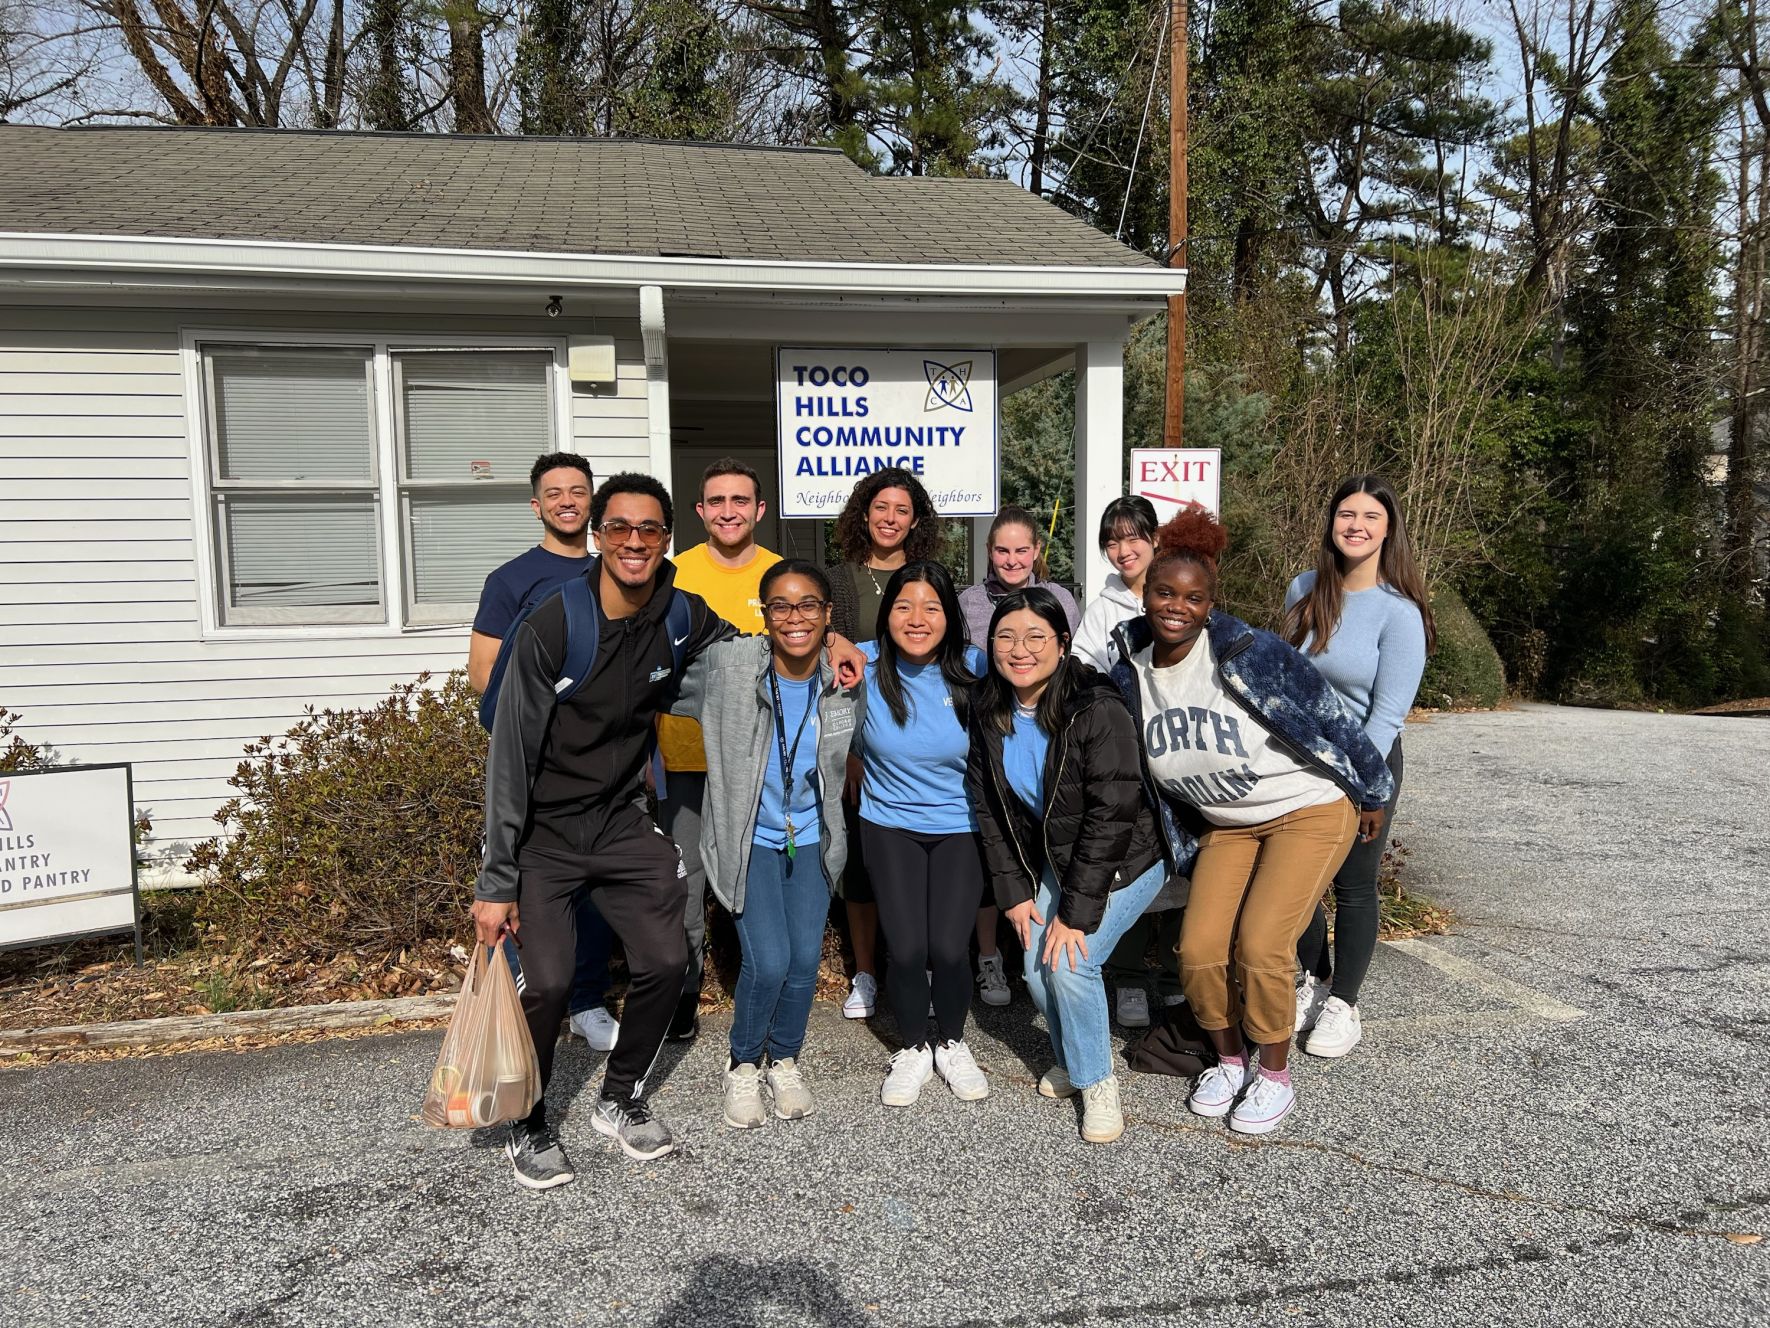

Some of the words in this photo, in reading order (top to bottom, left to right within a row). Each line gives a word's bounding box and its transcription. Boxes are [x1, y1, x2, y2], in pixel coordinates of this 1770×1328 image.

[793, 366, 869, 387] TOCO
[795, 396, 869, 417] HILLS
[796, 426, 966, 447] COMMUNITY
[796, 456, 925, 476] ALLIANCE
[1140, 461, 1211, 482] EXIT
[796, 490, 850, 508] Neighbo
[1146, 706, 1250, 759] ORTH
[1163, 763, 1261, 808] ROLINA
[0, 853, 51, 872] NTRY
[22, 868, 91, 891] PANTRY
